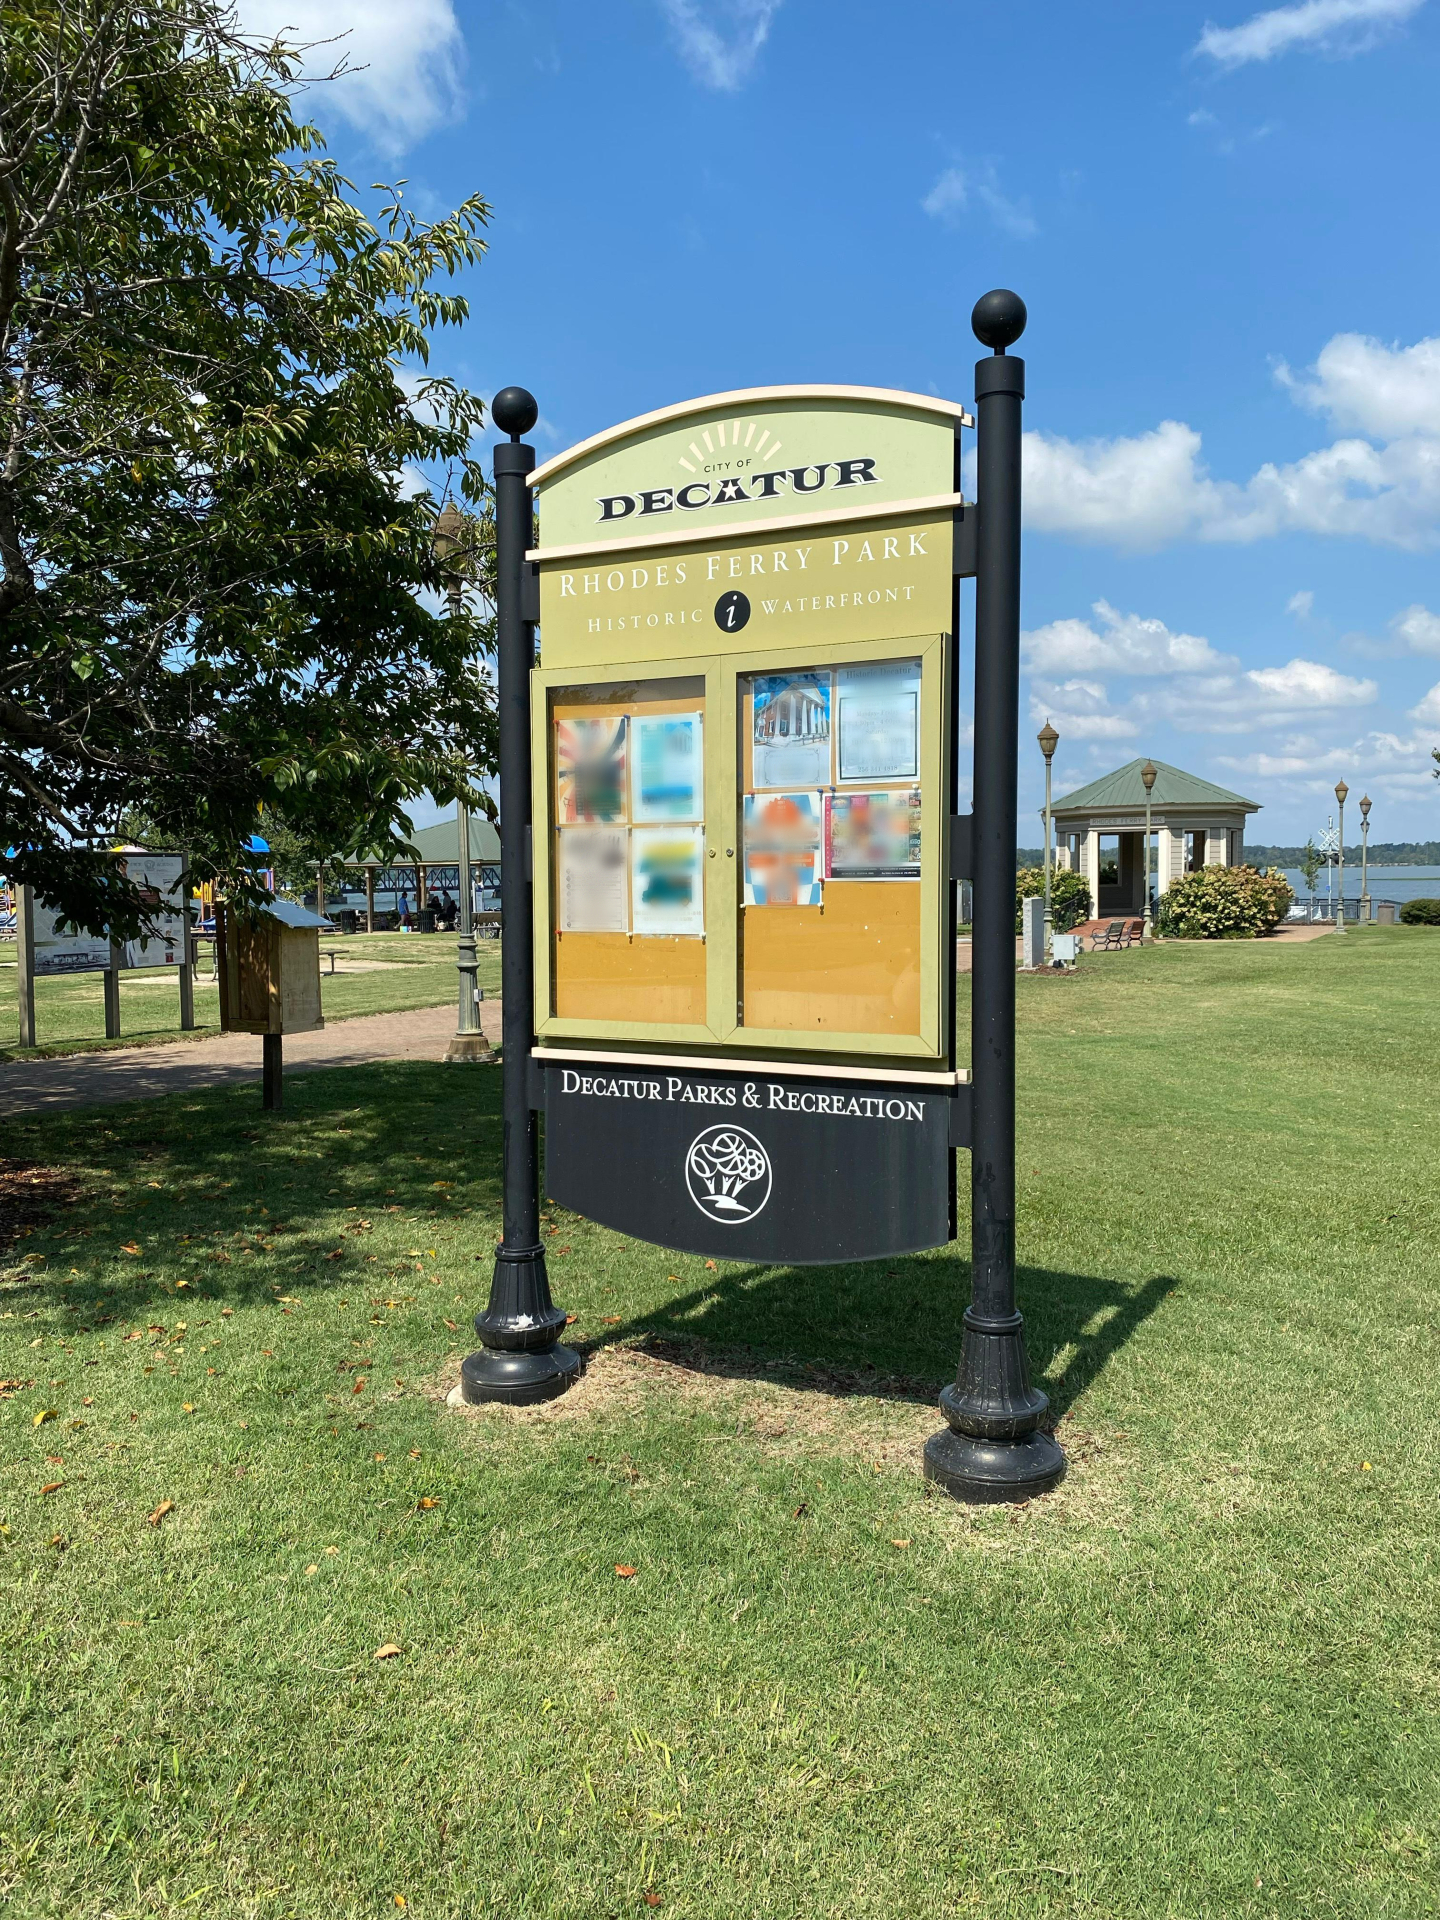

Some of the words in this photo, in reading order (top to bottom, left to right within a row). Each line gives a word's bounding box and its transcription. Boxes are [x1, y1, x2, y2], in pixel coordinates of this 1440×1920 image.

[704, 462, 731, 473] CITY
[736, 458, 752, 468] OF
[594, 457, 884, 524] DECATUR
[560, 562, 687, 597] RHODES
[706, 547, 813, 581] FERRY
[832, 532, 928, 565] PARK
[588, 609, 703, 633] HISTORIC
[761, 586, 915, 615] WATERFRONT
[846, 668, 877, 679] Historic
[880, 667, 912, 676] Decatur
[561, 1070, 662, 1100] DECATUR
[666, 1077, 737, 1106] PARKS
[742, 1082, 763, 1109] &
[767, 1084, 926, 1122] RECREATION
